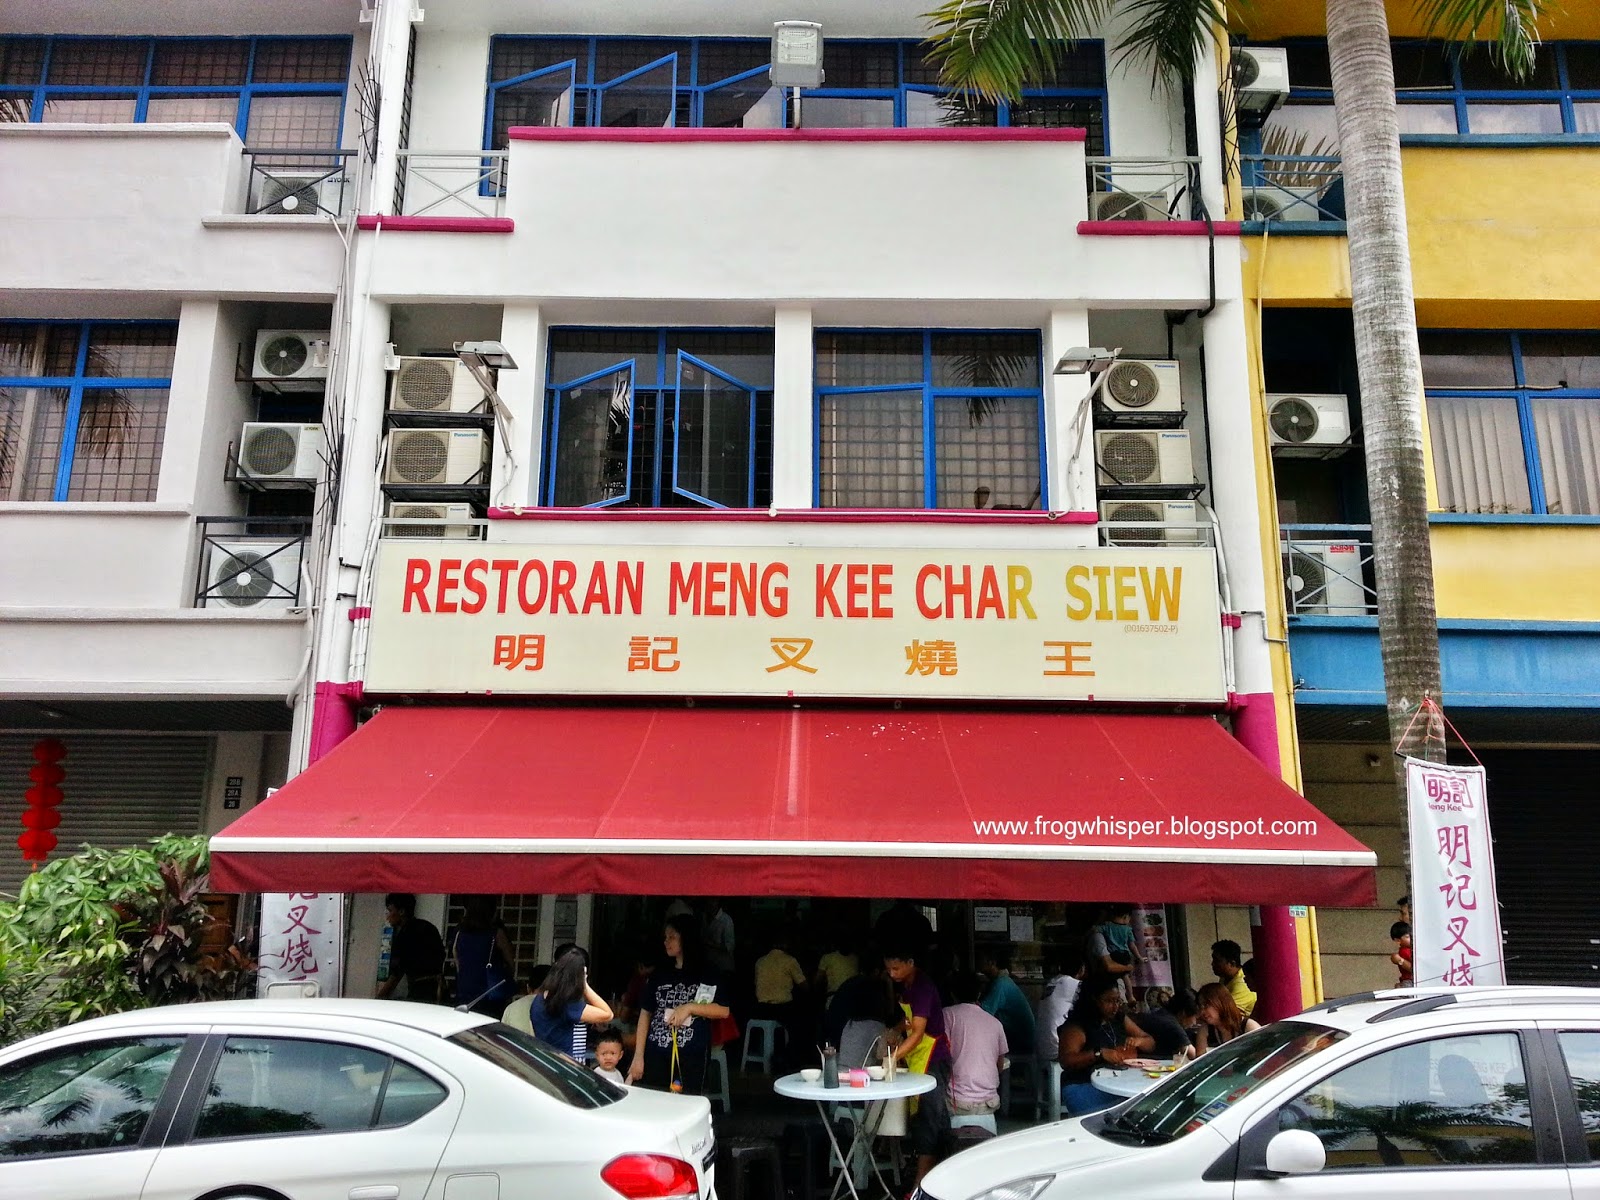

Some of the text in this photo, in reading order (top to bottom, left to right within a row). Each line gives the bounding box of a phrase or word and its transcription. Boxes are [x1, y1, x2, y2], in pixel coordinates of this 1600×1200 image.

[402, 558, 1183, 622] RESTORAN MENG KEE CHAR SIEW
[1123, 623, 1179, 634] (001637502-P)
[1447, 803, 1462, 812] Kee
